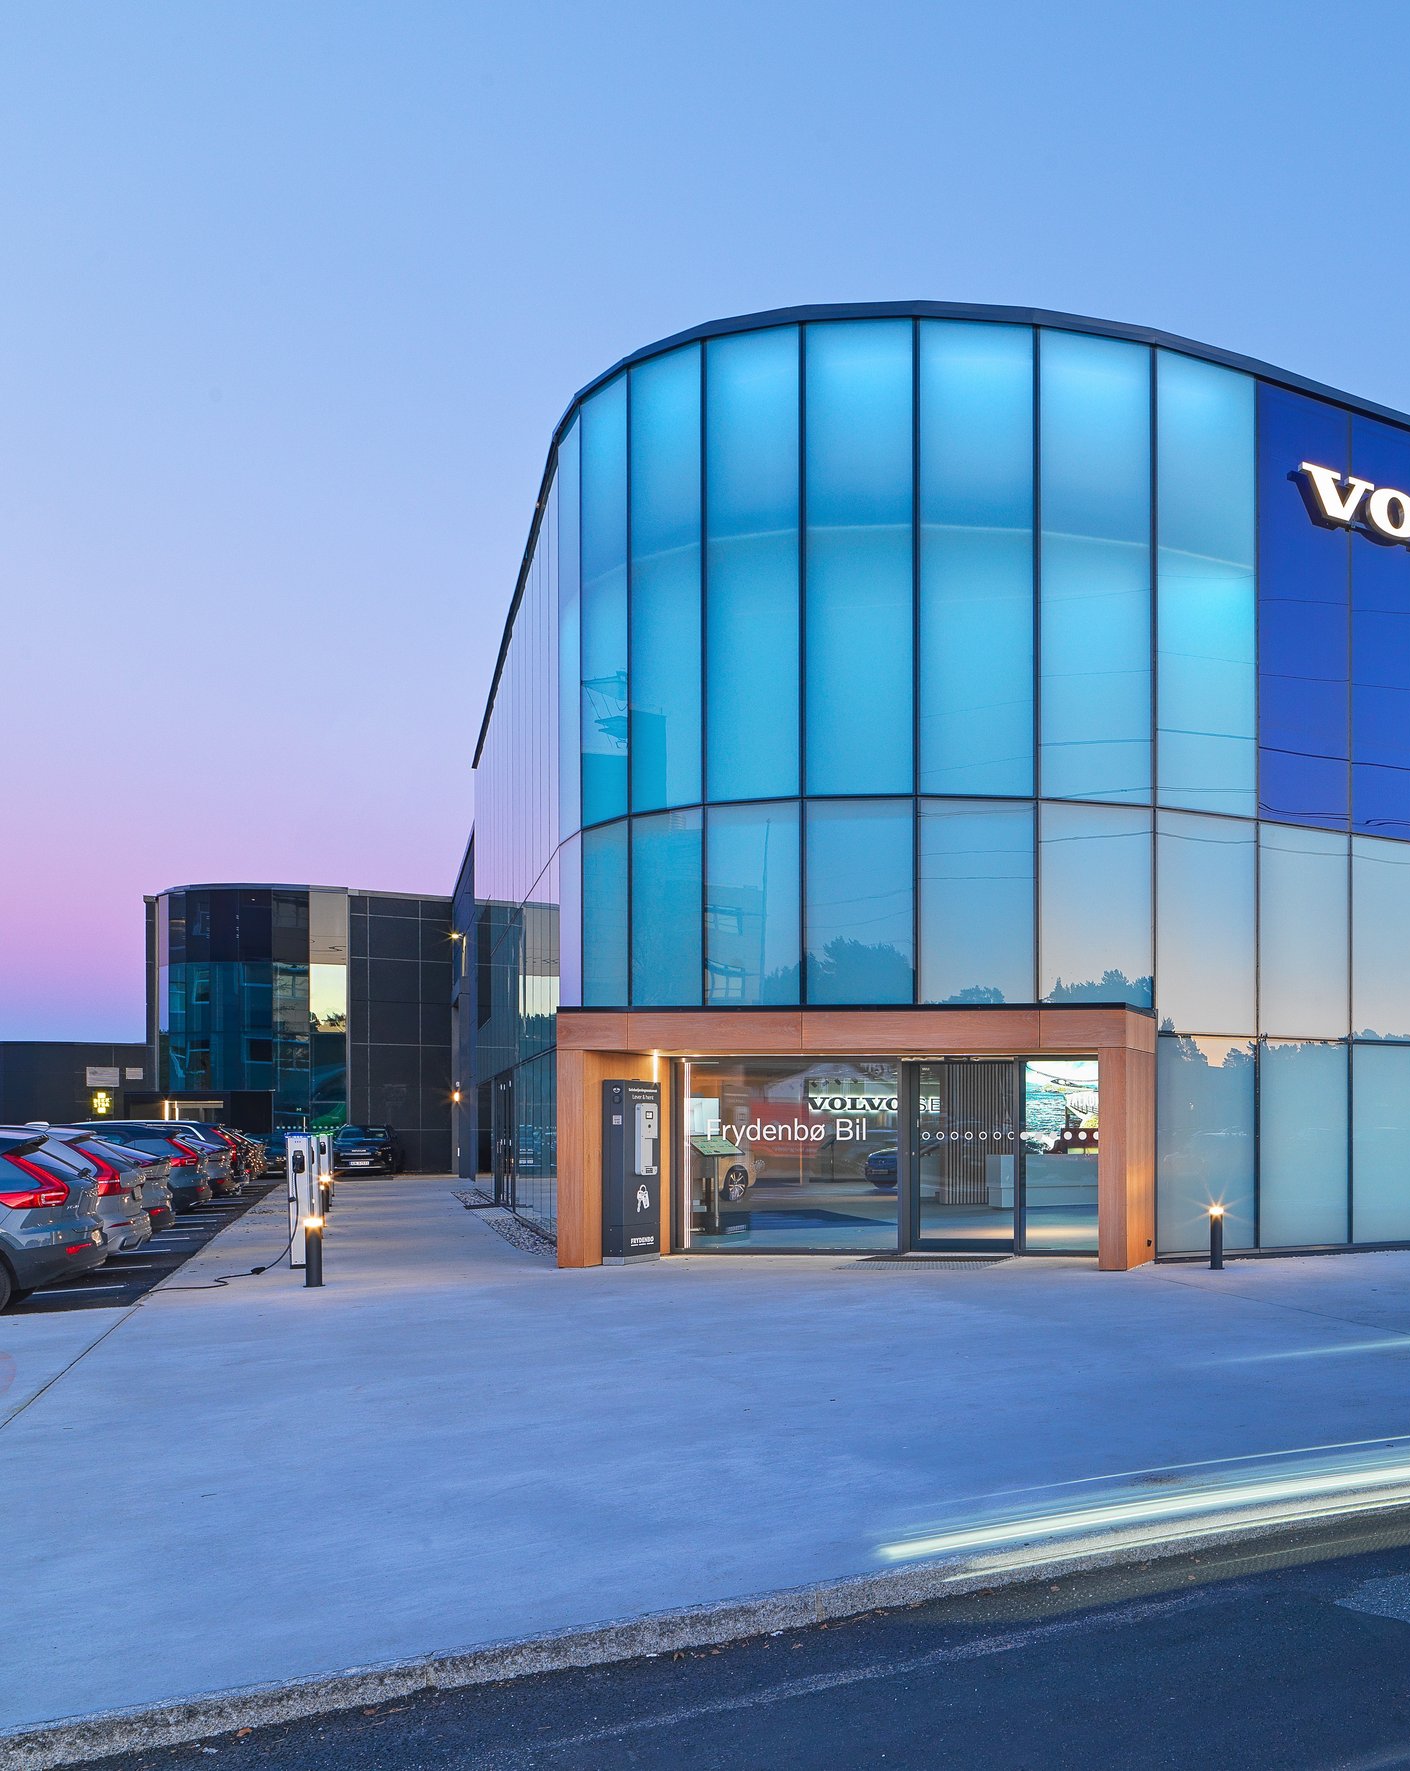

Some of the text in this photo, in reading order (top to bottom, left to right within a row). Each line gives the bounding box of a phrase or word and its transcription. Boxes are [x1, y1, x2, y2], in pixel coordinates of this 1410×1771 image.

[808, 1096, 898, 1111] VOLVO
[707, 1117, 826, 1147] Frydenbø
[836, 1117, 867, 1141] Bil
